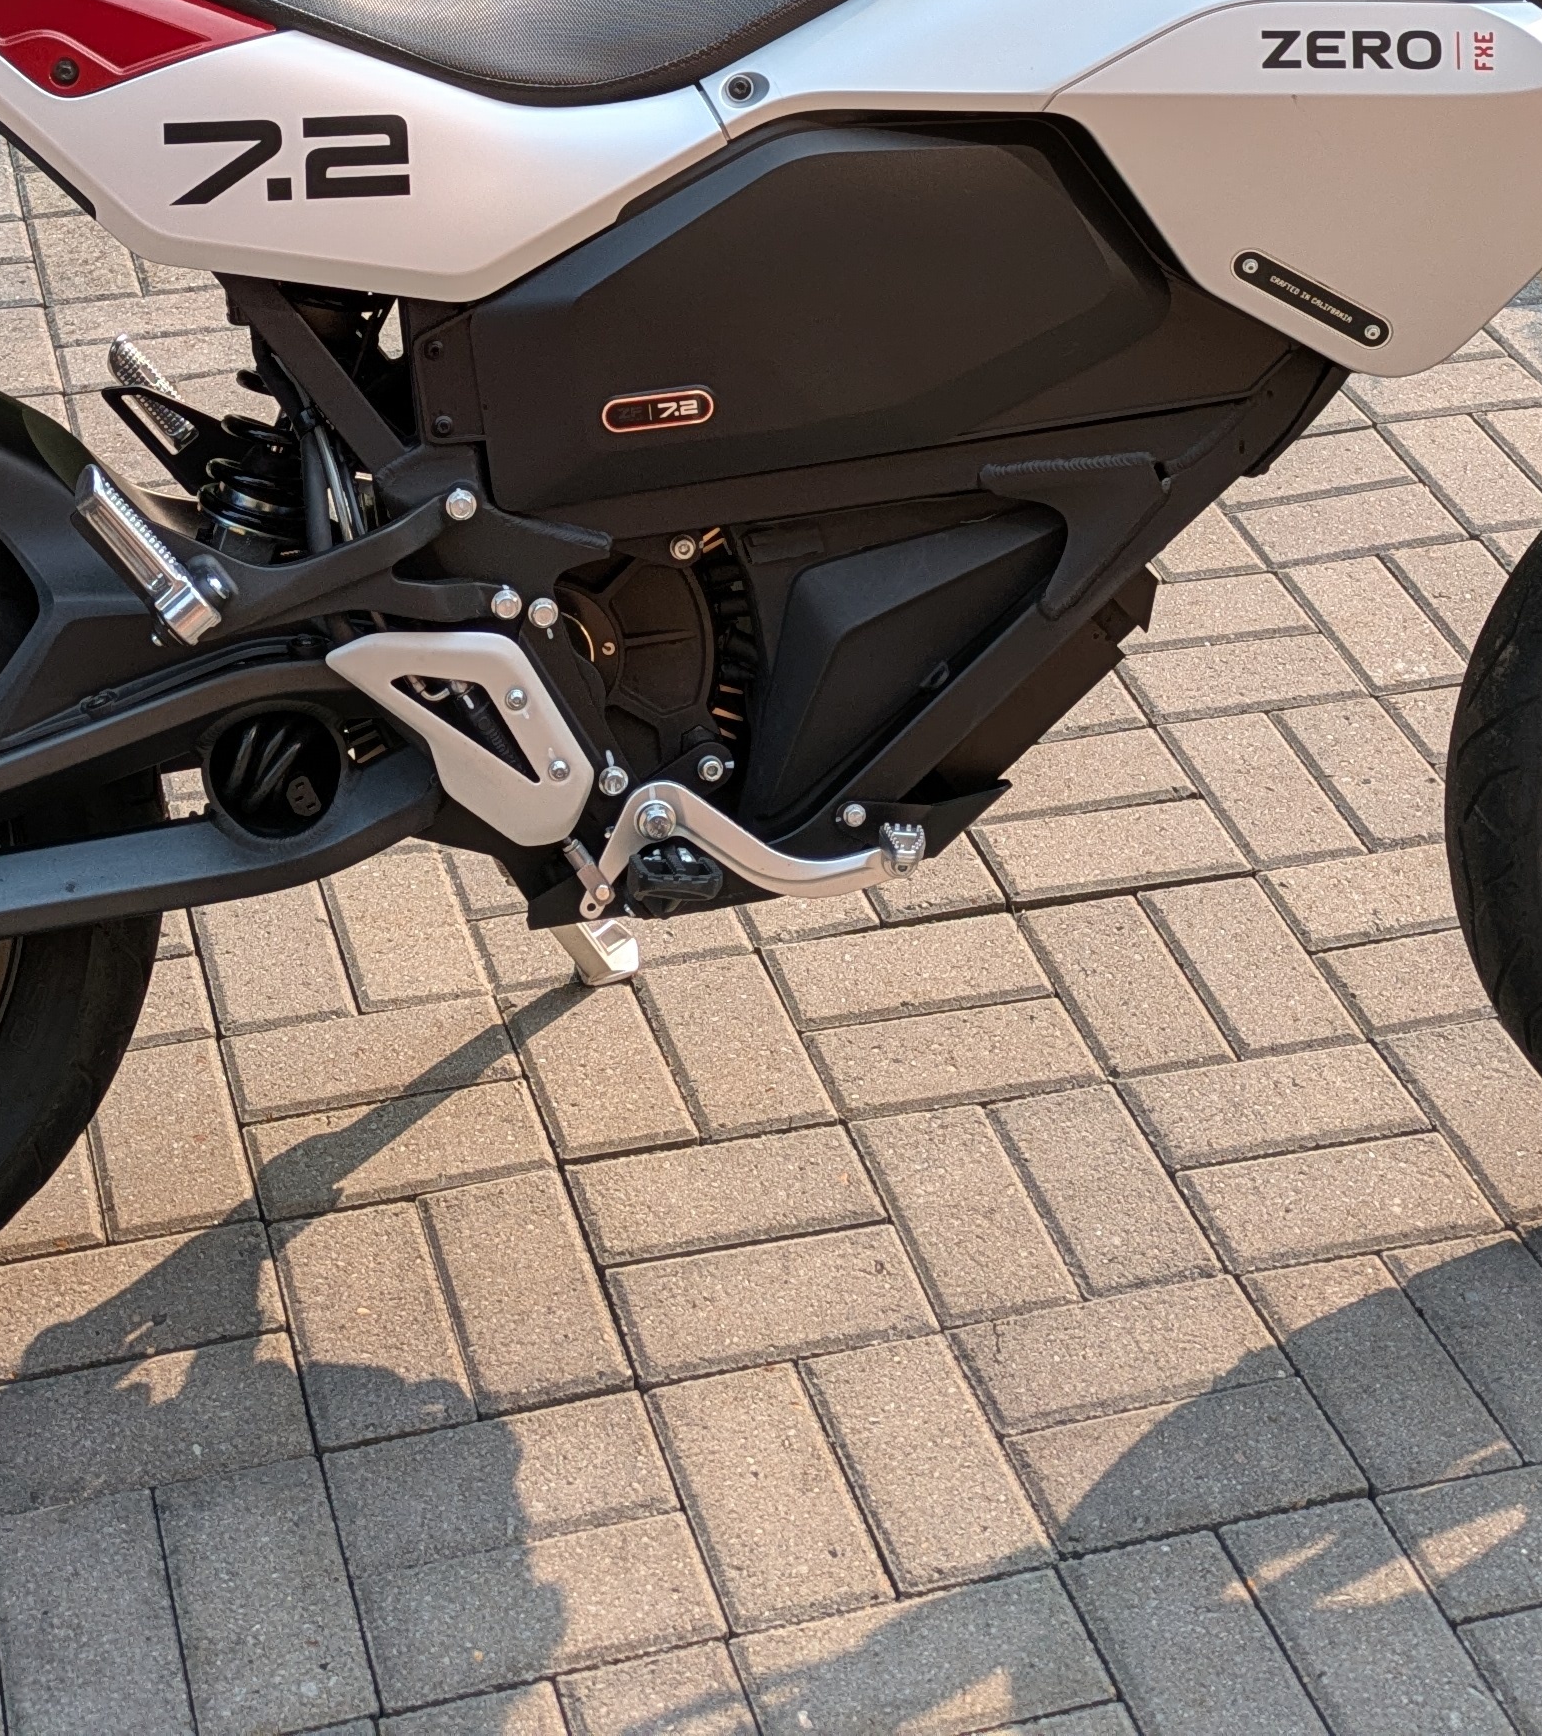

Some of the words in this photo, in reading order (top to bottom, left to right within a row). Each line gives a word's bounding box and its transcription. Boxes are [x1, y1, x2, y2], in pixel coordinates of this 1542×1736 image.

[1261, 29, 1442, 70] ZERO
[1473, 31, 1494, 71] FXE
[163, 113, 411, 206] 7.2
[1269, 275, 1301, 295] CRAFTED
[1300, 291, 1312, 301] IN
[1311, 297, 1353, 324] CALIFORNIA
[657, 399, 699, 418] 7.2
